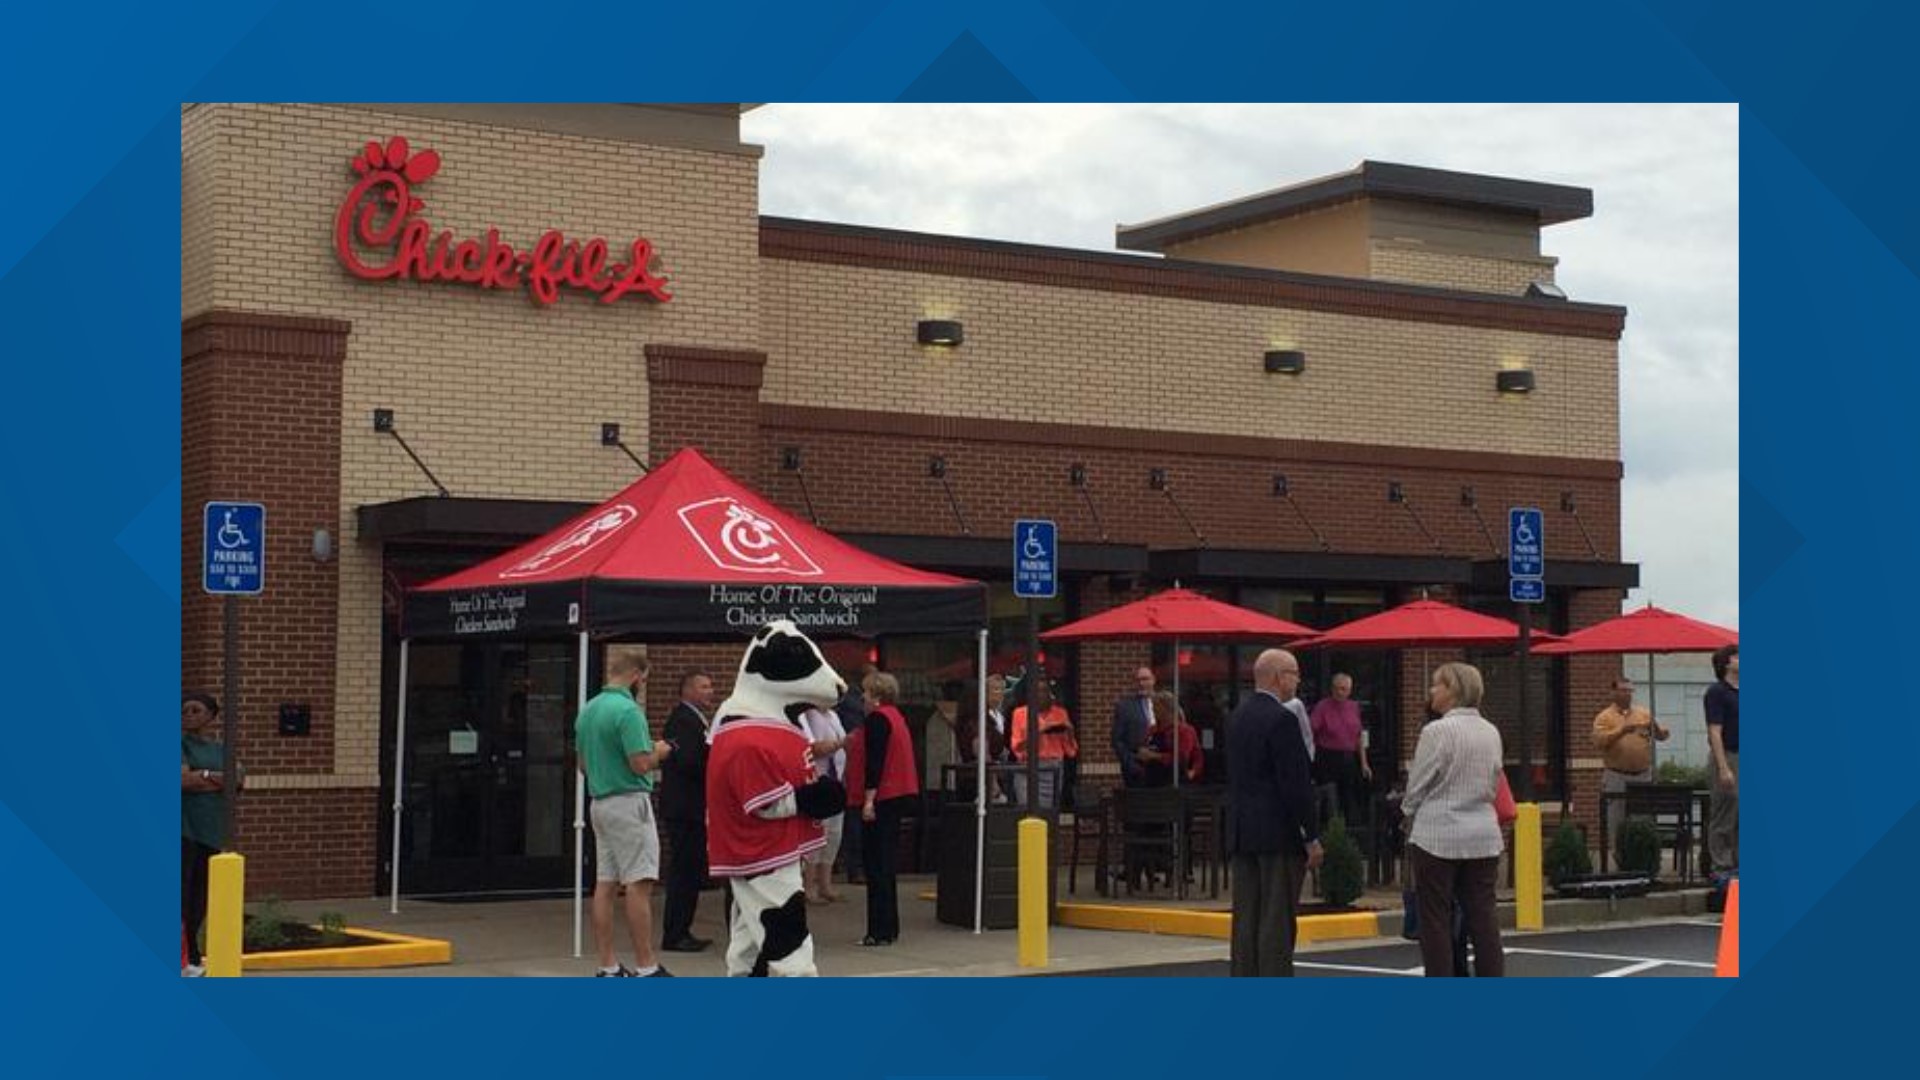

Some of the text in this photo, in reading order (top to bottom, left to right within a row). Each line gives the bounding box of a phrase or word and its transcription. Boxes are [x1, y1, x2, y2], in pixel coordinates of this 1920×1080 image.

[334, 136, 673, 304] Chick-fil-A
[214, 549, 254, 563] PARKING
[709, 584, 878, 607] Home Of The Original
[726, 607, 787, 626] Chicken
